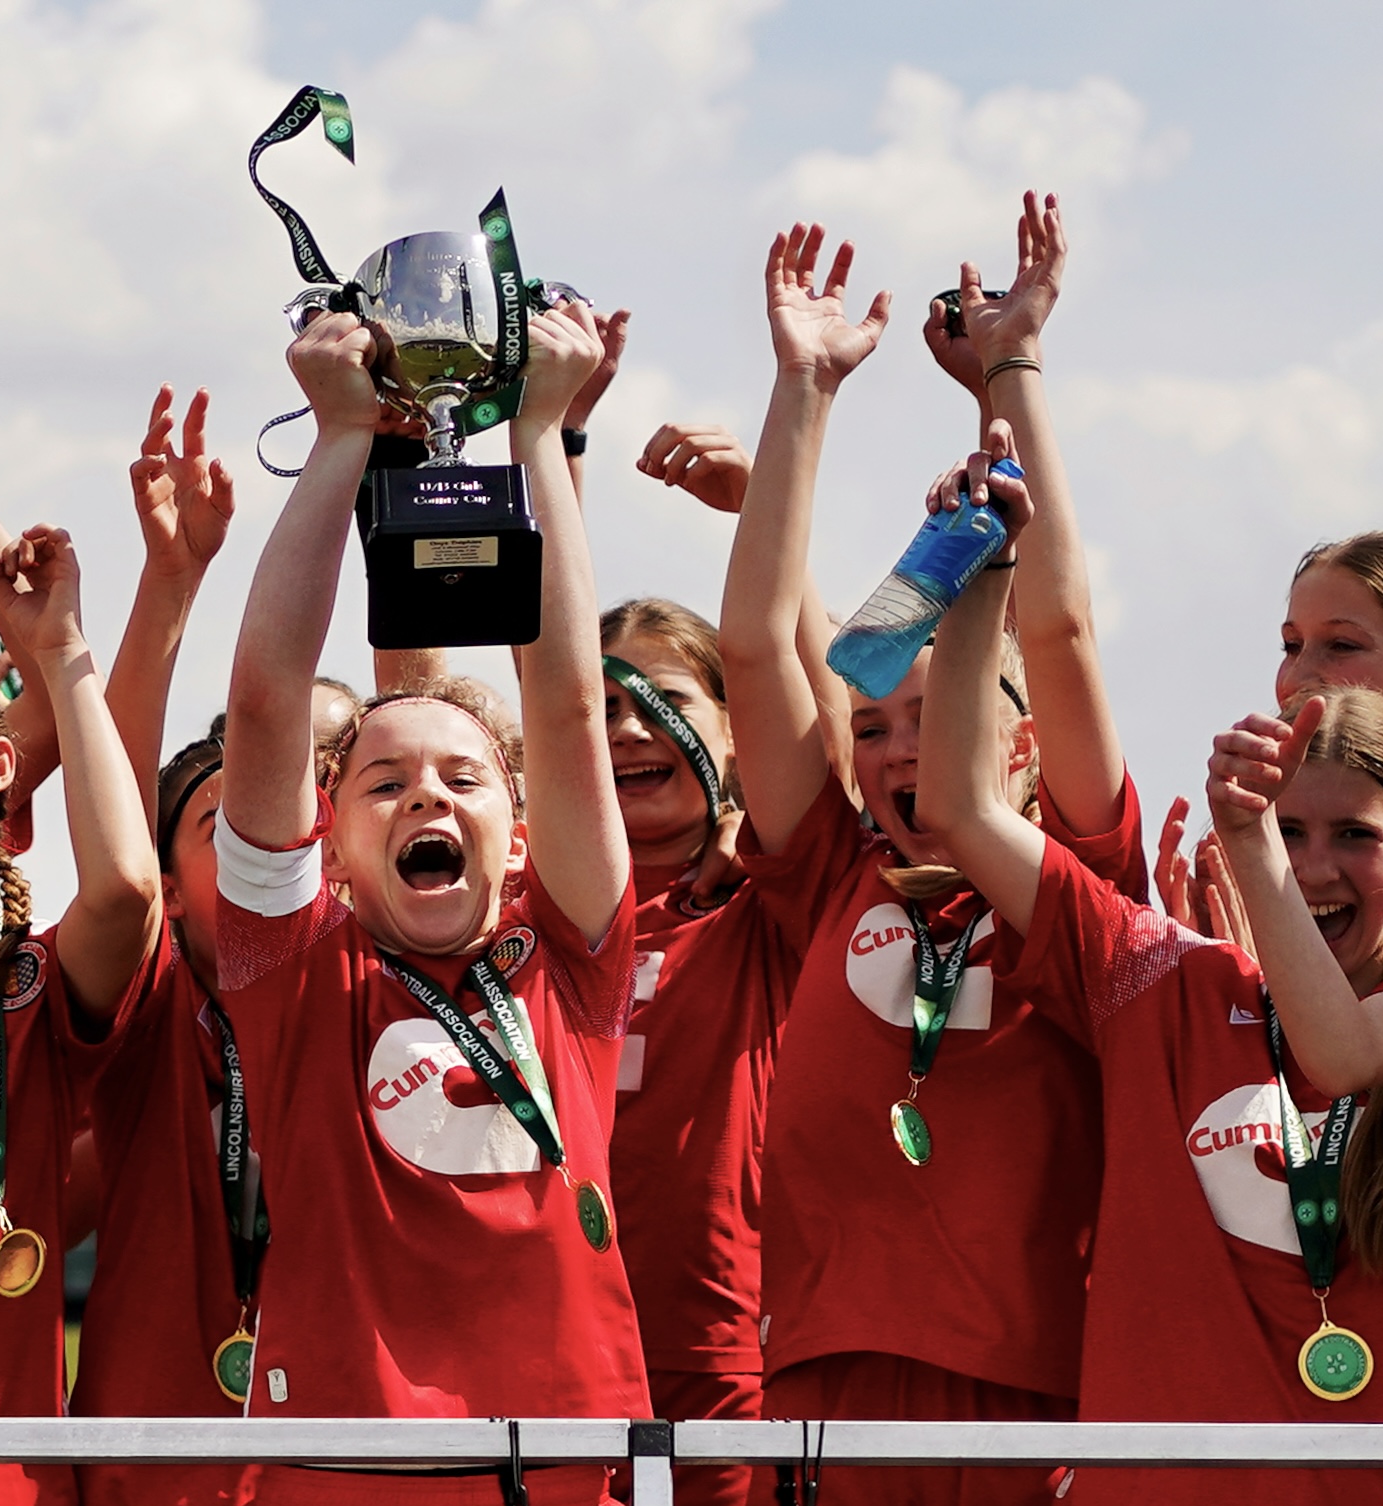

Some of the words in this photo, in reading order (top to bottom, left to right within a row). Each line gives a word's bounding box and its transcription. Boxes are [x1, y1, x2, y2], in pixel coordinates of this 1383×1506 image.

[627, 673, 700, 750] ASSOCIATION
[432, 1001, 502, 1080] ASSOCIATION
[481, 980, 533, 1062] ASSOCIATION
[1325, 1094, 1352, 1166] LINCOLNS
